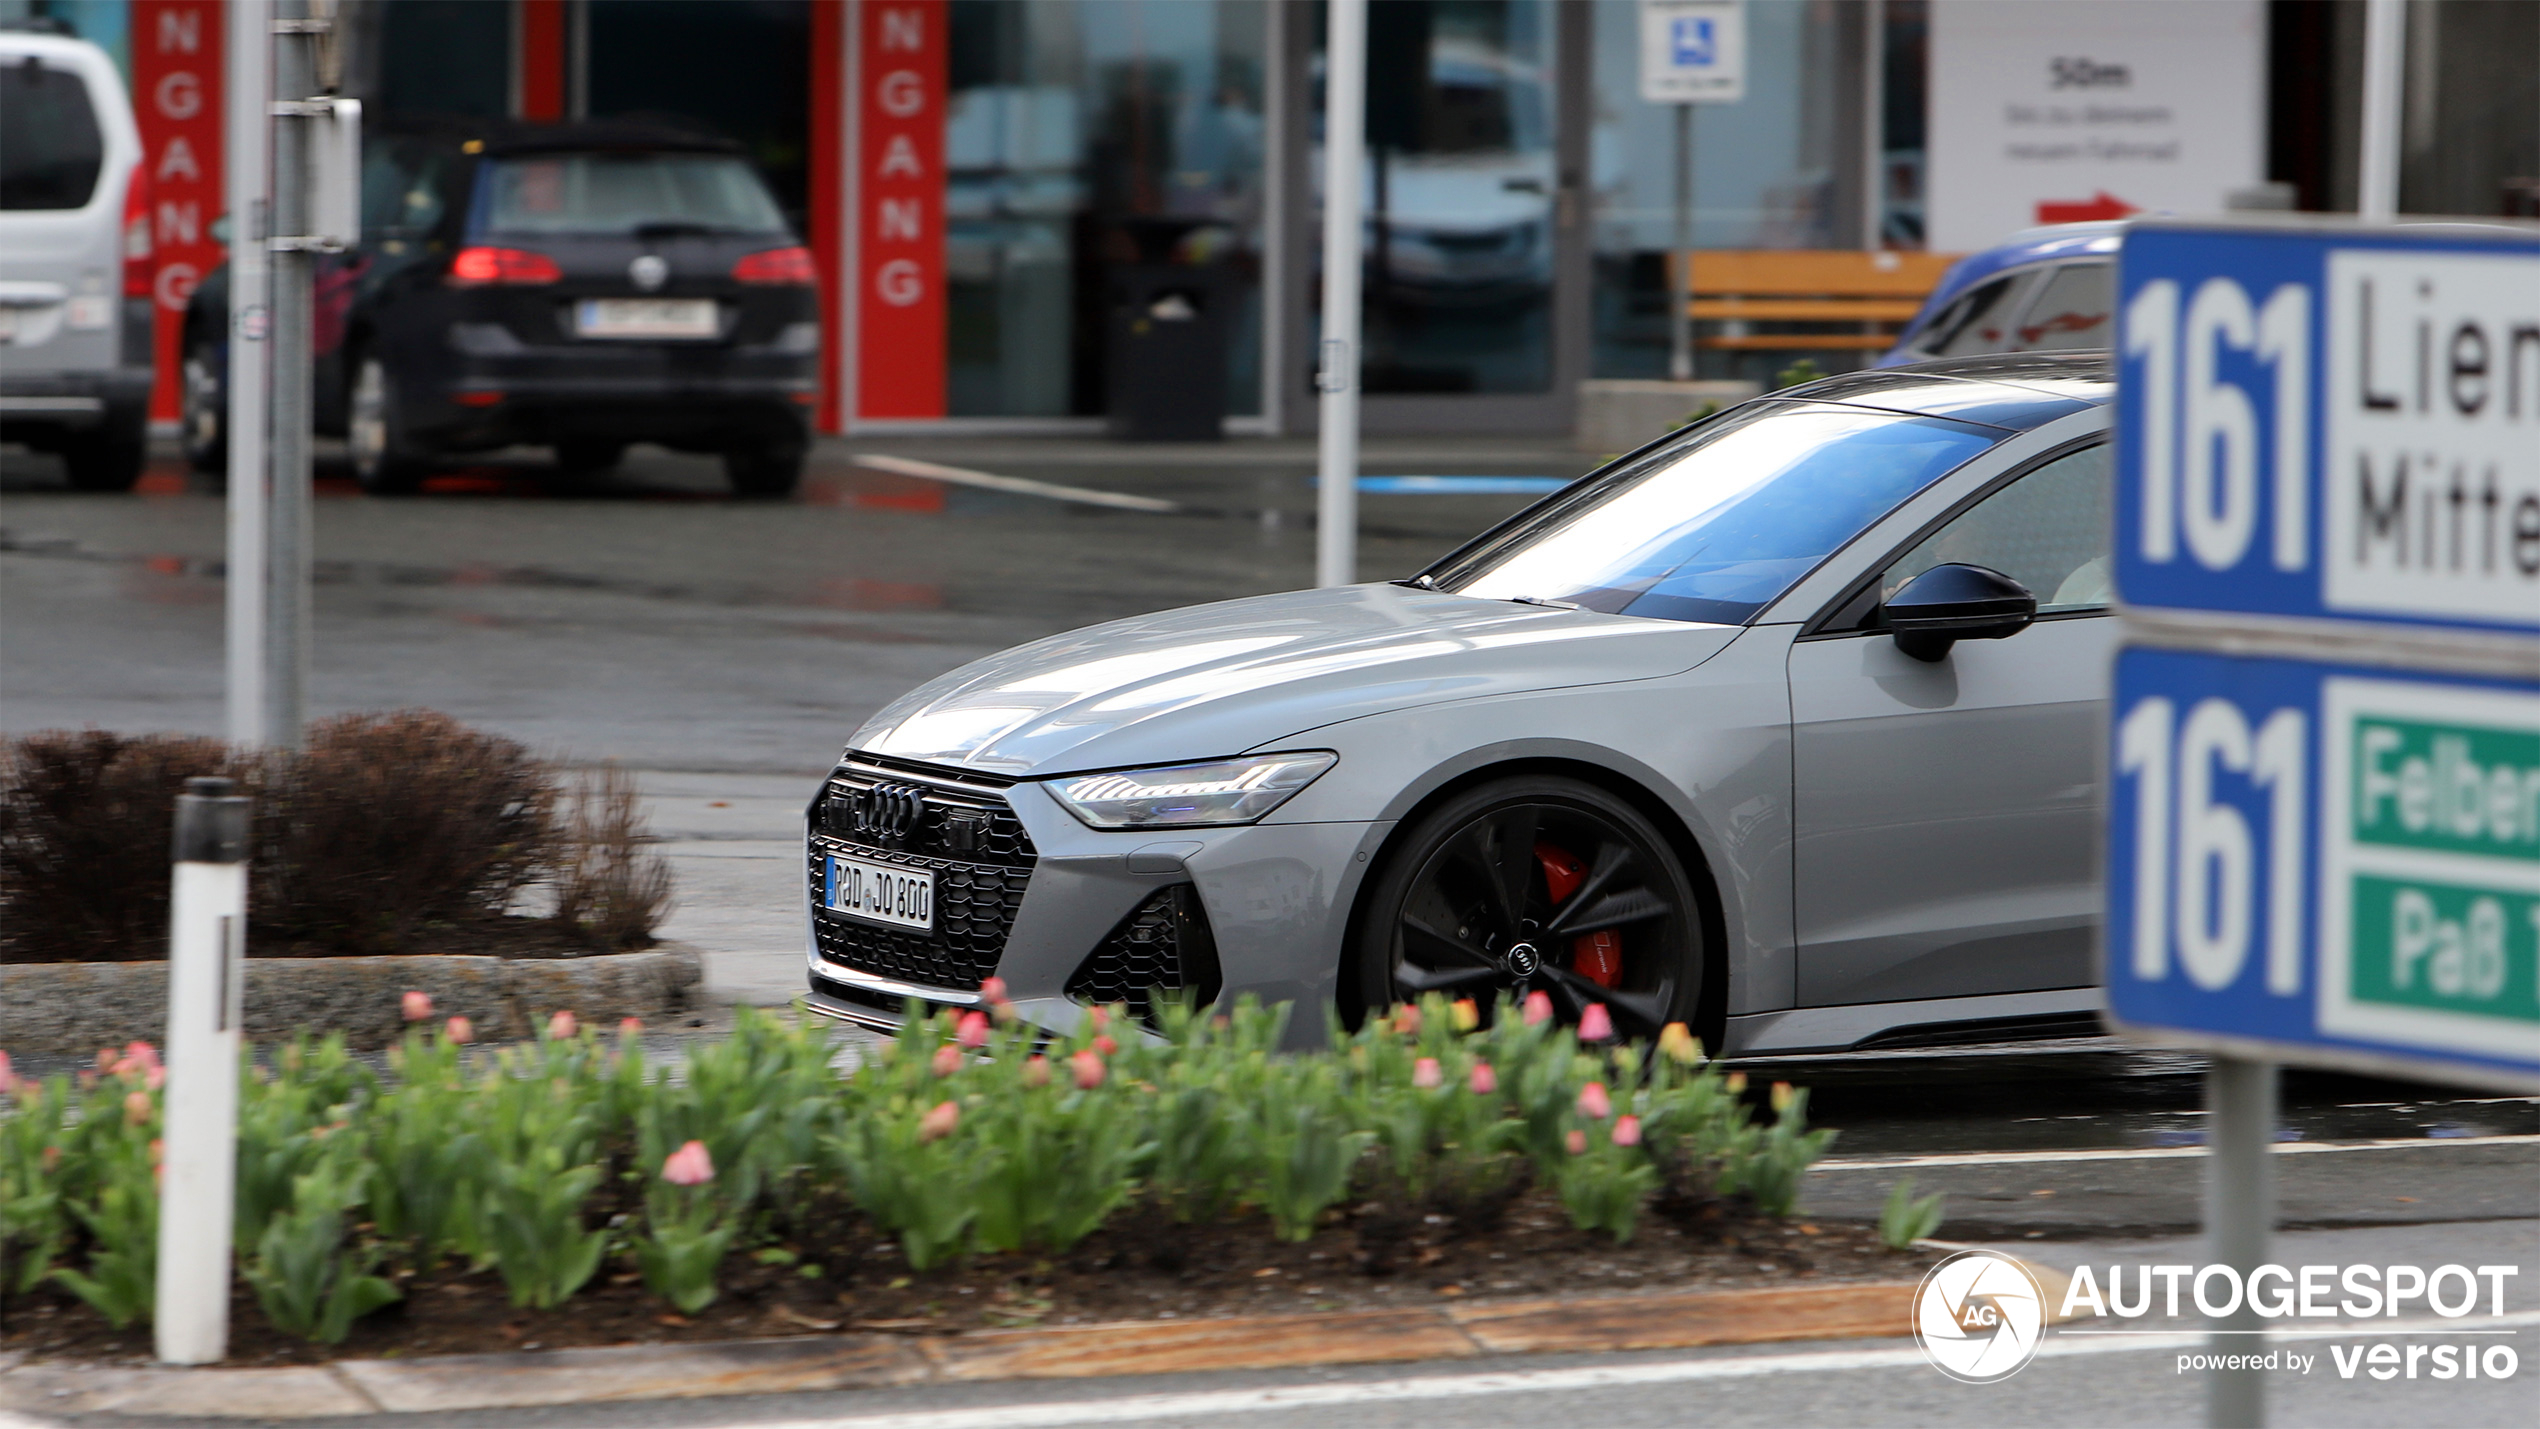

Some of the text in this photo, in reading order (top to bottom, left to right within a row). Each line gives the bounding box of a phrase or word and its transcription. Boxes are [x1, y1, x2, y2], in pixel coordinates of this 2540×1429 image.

[877, 9, 925, 307] NGANG
[2051, 56, 2131, 88] 50m
[2126, 277, 2312, 572] 161
[898, 876, 928, 921] 800
[2119, 696, 2307, 998] 161
